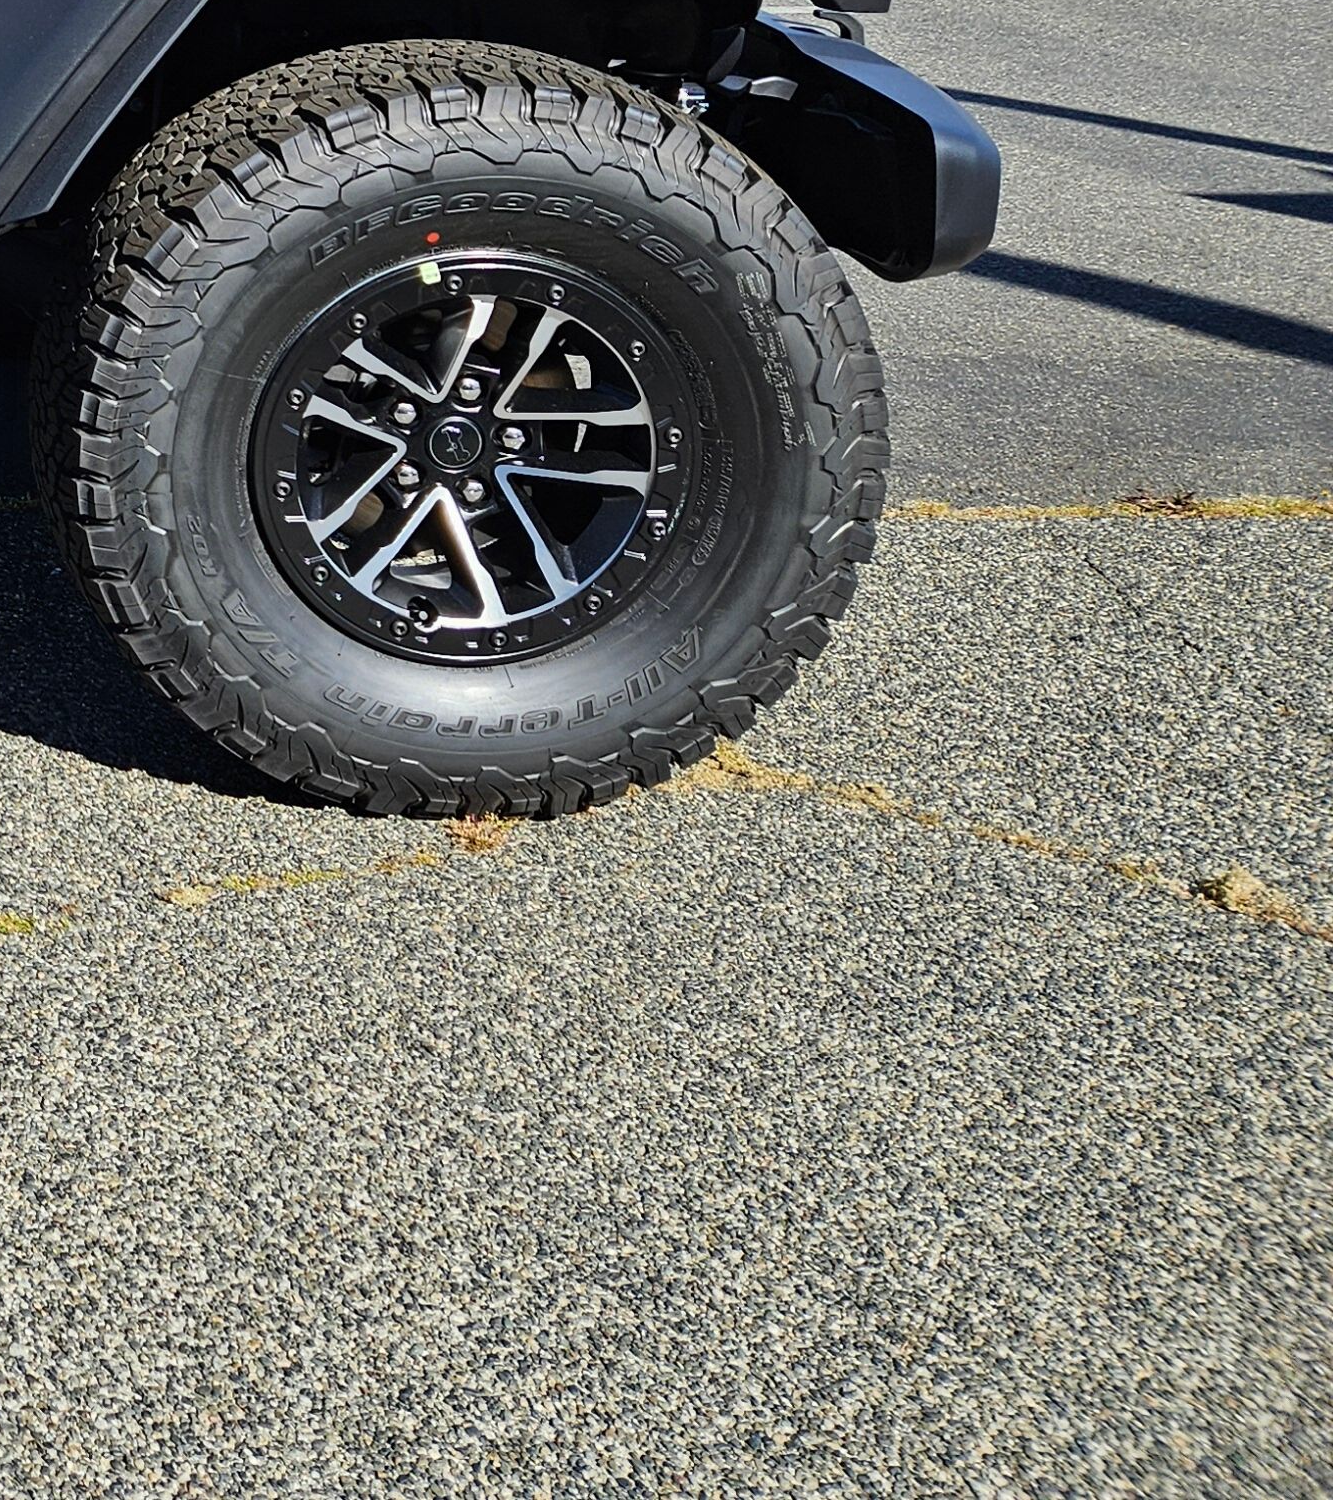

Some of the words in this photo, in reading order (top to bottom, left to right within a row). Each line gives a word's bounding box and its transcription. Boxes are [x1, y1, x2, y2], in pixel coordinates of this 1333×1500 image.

[309, 191, 720, 296] BFGoodrich
[222, 588, 300, 679] T/A
[323, 623, 706, 740] All-Terrain
